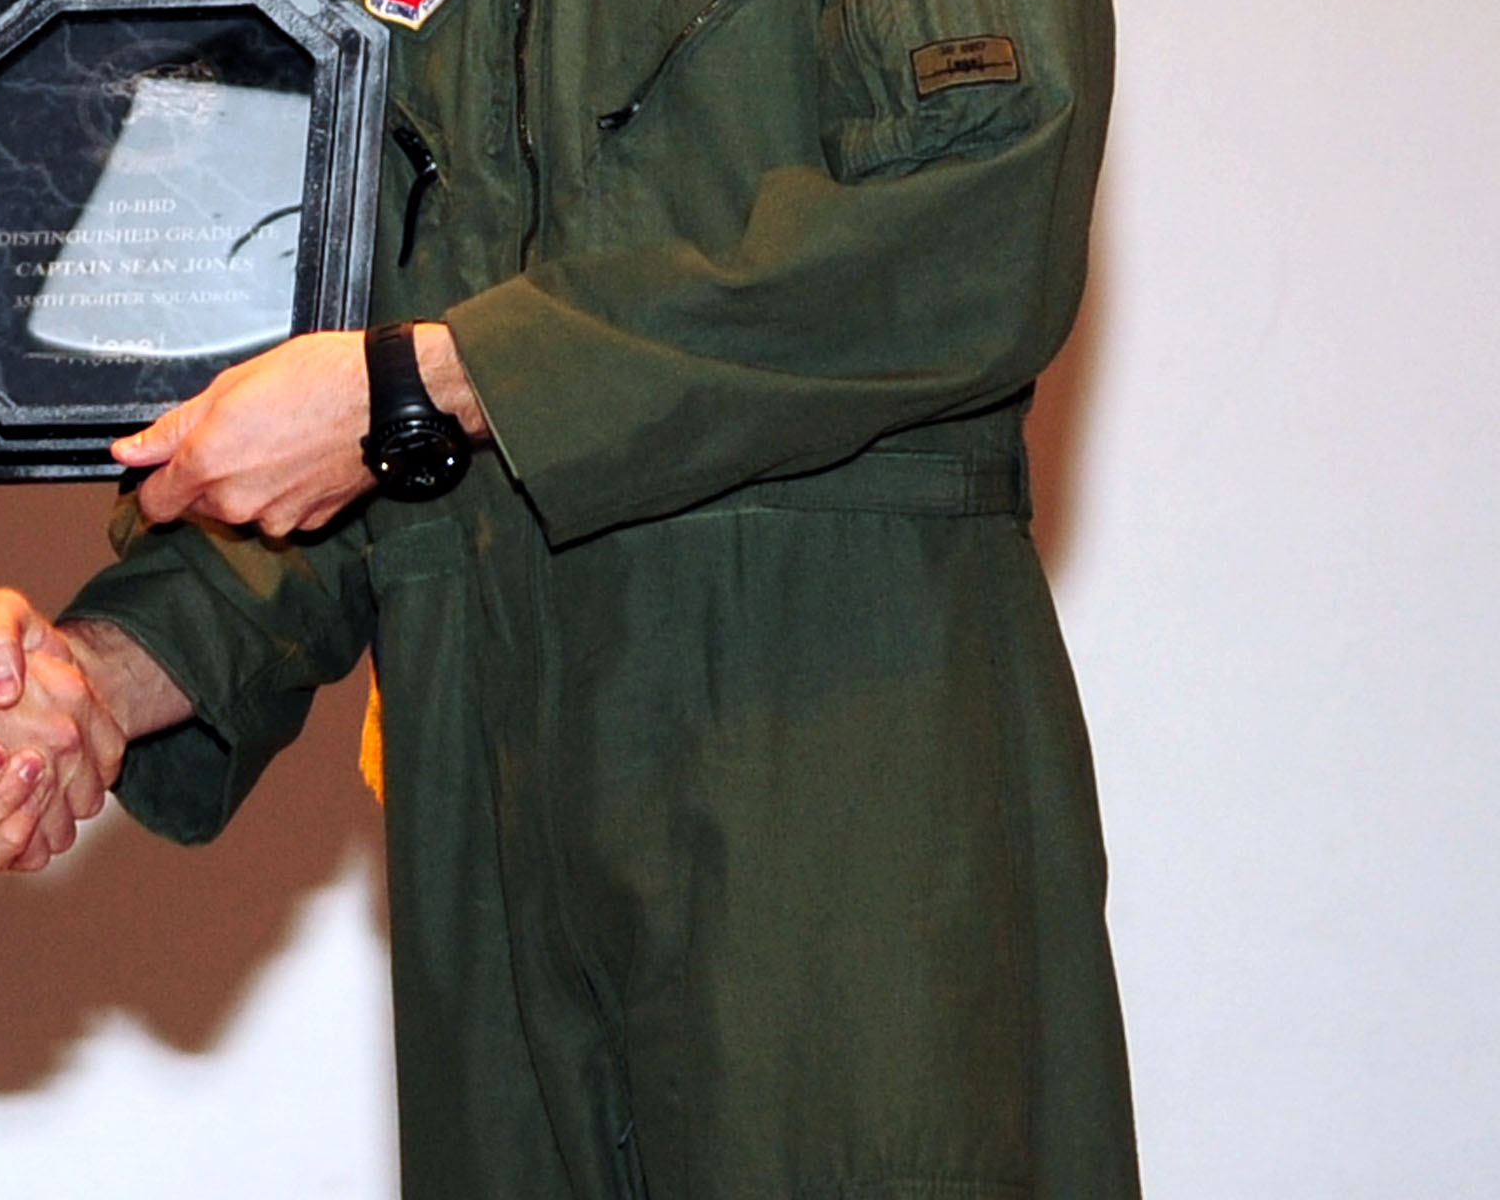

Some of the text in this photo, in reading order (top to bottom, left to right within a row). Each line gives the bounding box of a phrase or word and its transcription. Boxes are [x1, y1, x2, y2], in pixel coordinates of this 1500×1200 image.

[15, 257, 255, 277] CAPTAIN SEAN JONES
[68, 291, 145, 307] FIGHTER
